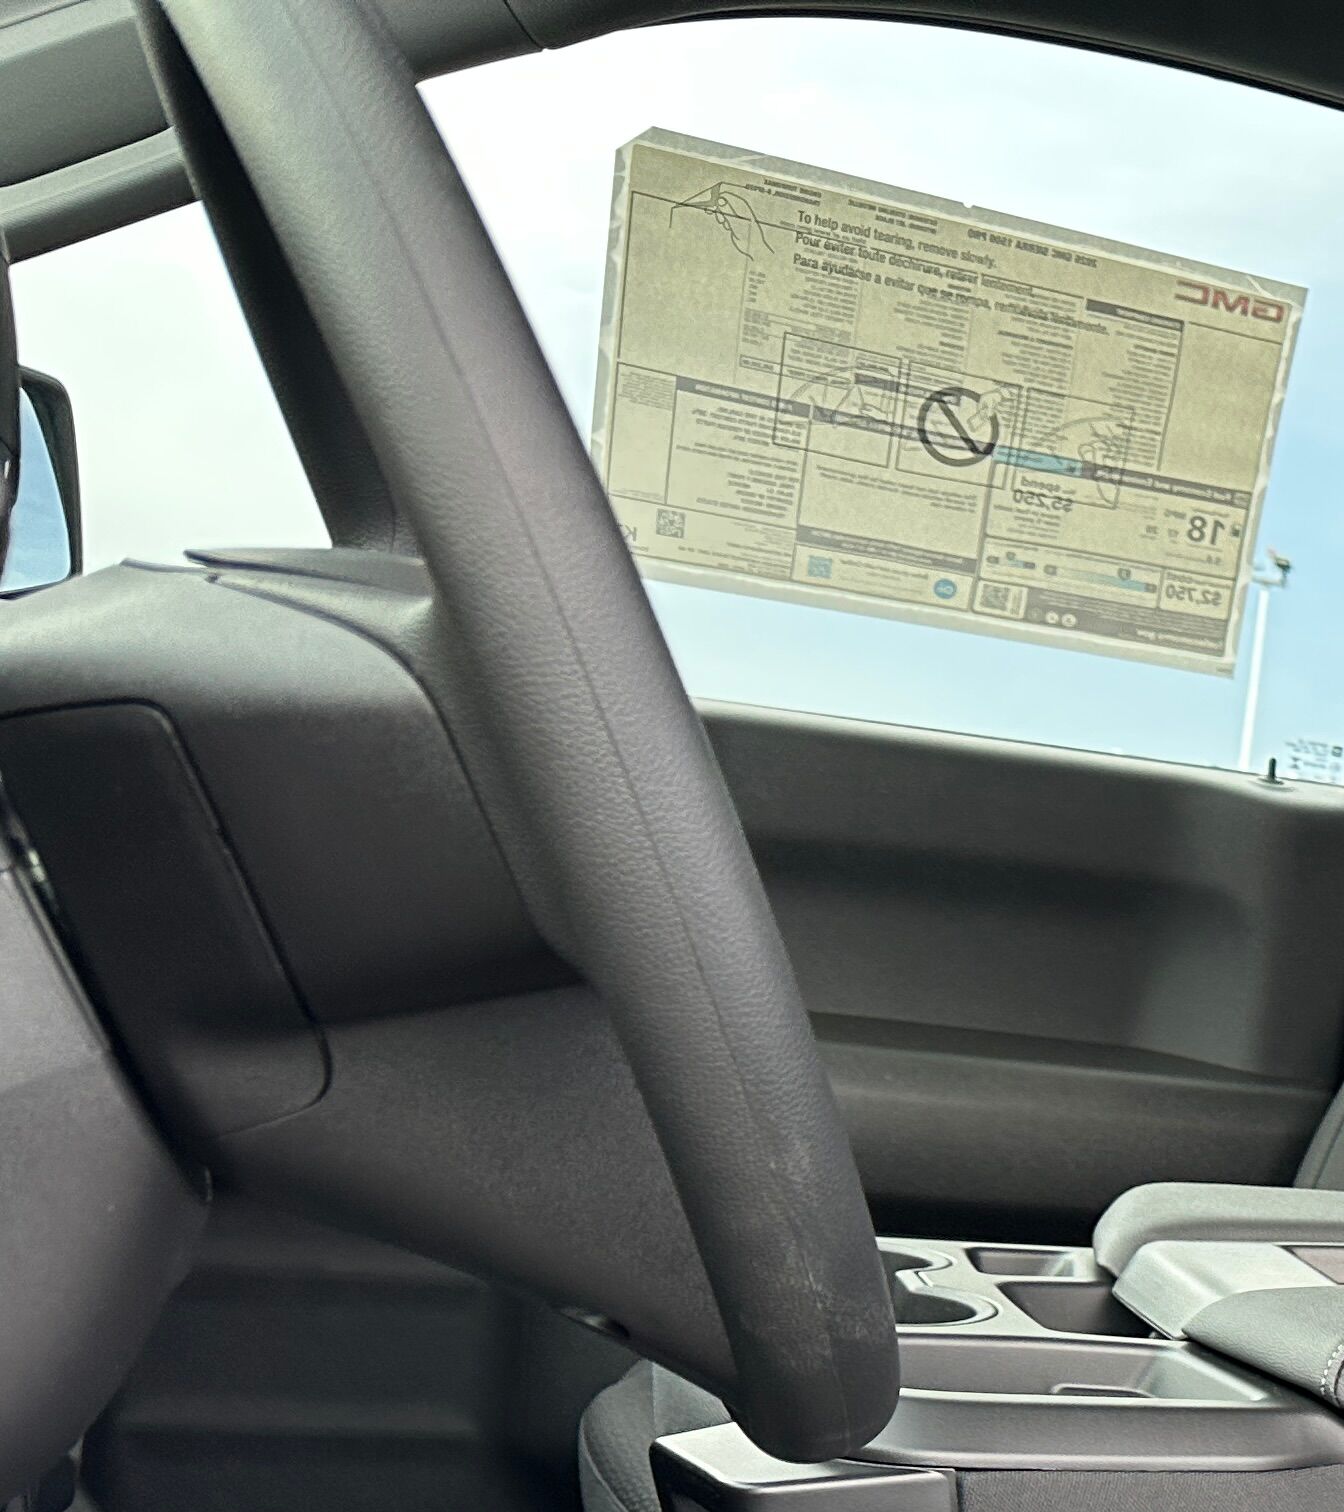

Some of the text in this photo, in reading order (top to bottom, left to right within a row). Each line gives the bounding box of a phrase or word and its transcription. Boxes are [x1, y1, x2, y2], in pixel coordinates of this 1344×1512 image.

[796, 210, 811, 225] To
[813, 213, 838, 234] help
[839, 219, 871, 238] avoid
[872, 227, 915, 251] tearing,
